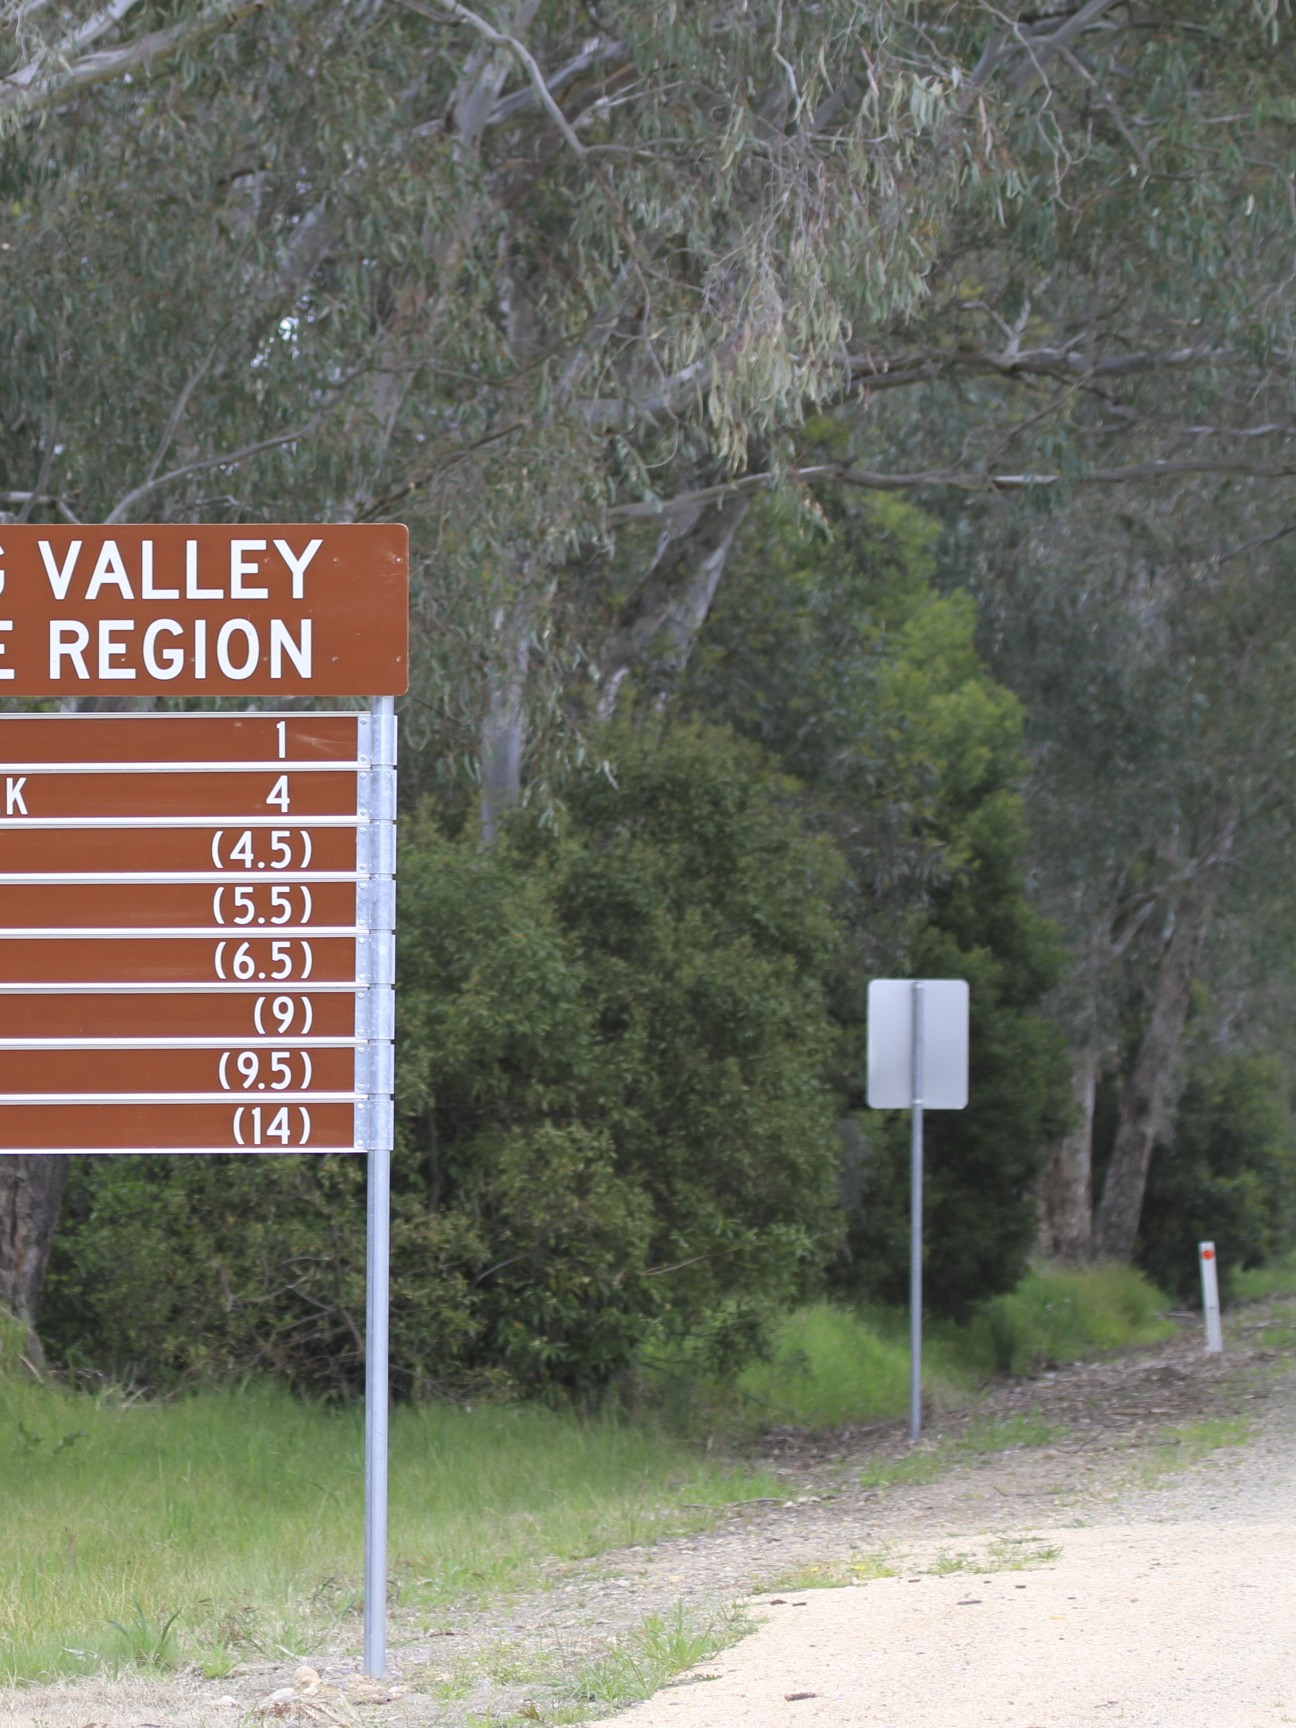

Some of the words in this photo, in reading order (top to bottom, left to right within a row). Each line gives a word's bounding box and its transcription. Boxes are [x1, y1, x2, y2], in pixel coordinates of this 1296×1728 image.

[38, 538, 324, 600] VALLEY
[50, 618, 312, 680] REGION
[276, 720, 286, 759] 1
[265, 774, 291, 813] 4
[211, 830, 312, 869] (4.5)
[212, 885, 312, 925] (5.5)
[214, 940, 313, 980] (6.5)
[253, 995, 313, 1035] (9)
[218, 1050, 313, 1091] (9.5)
[232, 1106, 311, 1145] (14)
